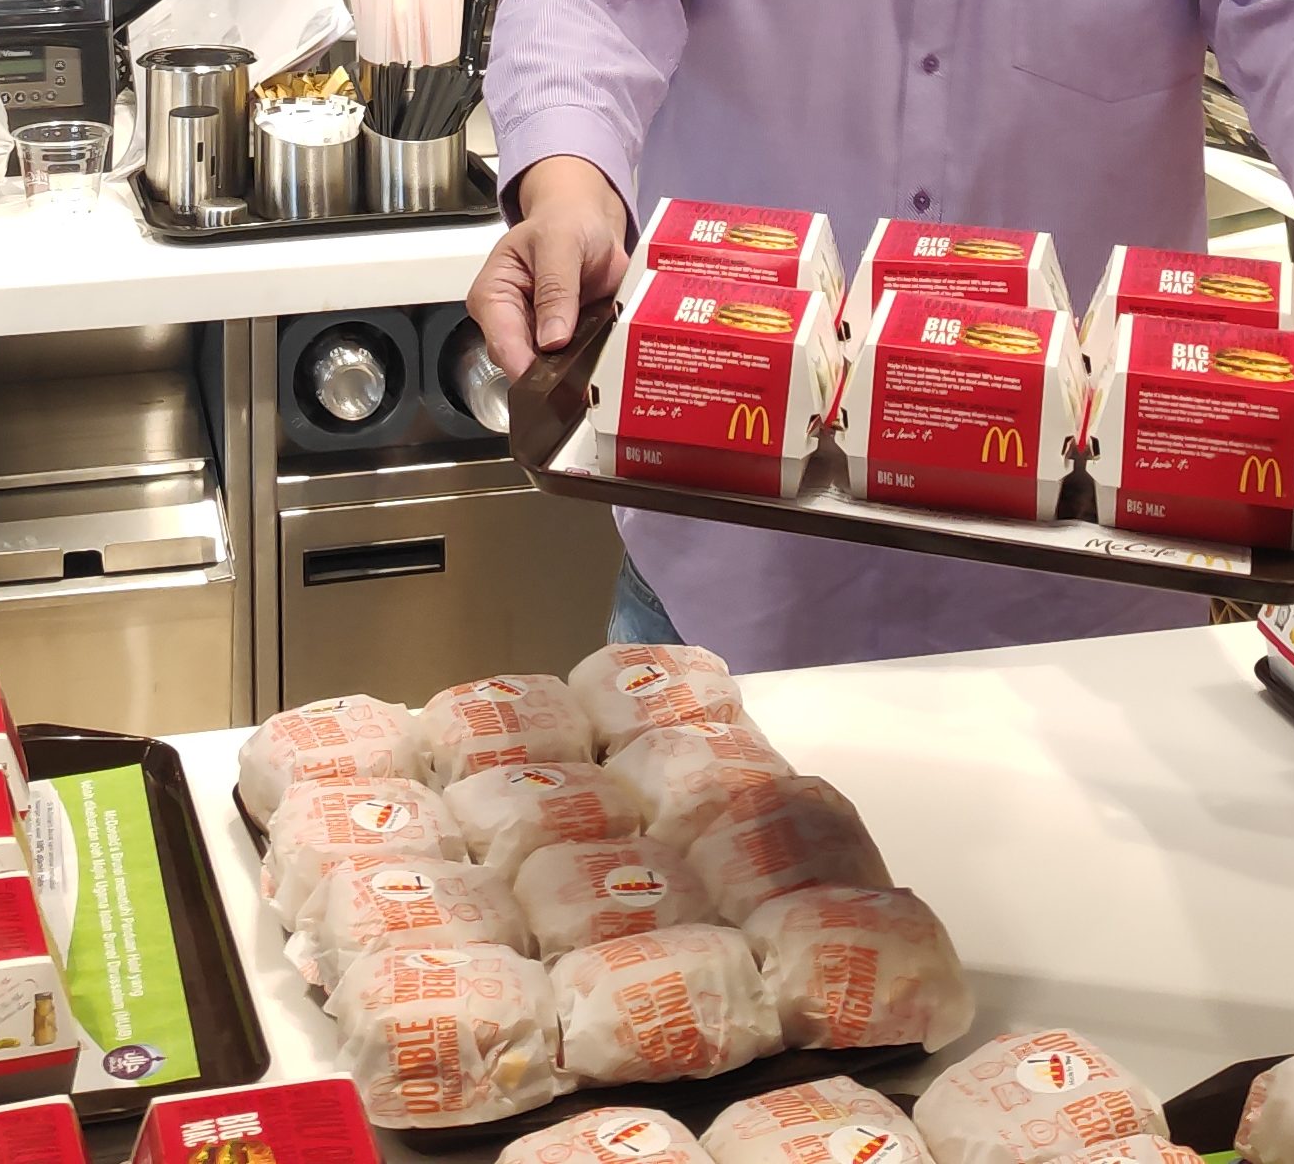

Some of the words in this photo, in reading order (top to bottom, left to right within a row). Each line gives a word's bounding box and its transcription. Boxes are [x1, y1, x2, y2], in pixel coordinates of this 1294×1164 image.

[693, 219, 728, 233] BIG
[689, 231, 725, 244] MAC
[916, 237, 950, 249] BIG
[913, 246, 947, 257] MAC
[1160, 269, 1195, 284] BIG
[1158, 281, 1194, 295] MAC
[679, 297, 716, 314] BIG
[674, 309, 713, 324] MAC
[924, 317, 962, 333] BIG
[921, 330, 959, 346] MAC
[1172, 343, 1209, 359] BIG
[1171, 357, 1209, 373] MAC
[625, 446, 641, 462] BIG
[643, 448, 663, 465] MAC
[877, 470, 893, 485] BIG
[895, 473, 915, 488] MAC
[1126, 498, 1143, 514] BIG
[1145, 502, 1166, 517] MAC
[395, 1017, 441, 1114] DOUBLE
[180, 1119, 216, 1148] MAC
[215, 1111, 264, 1142] BIG
